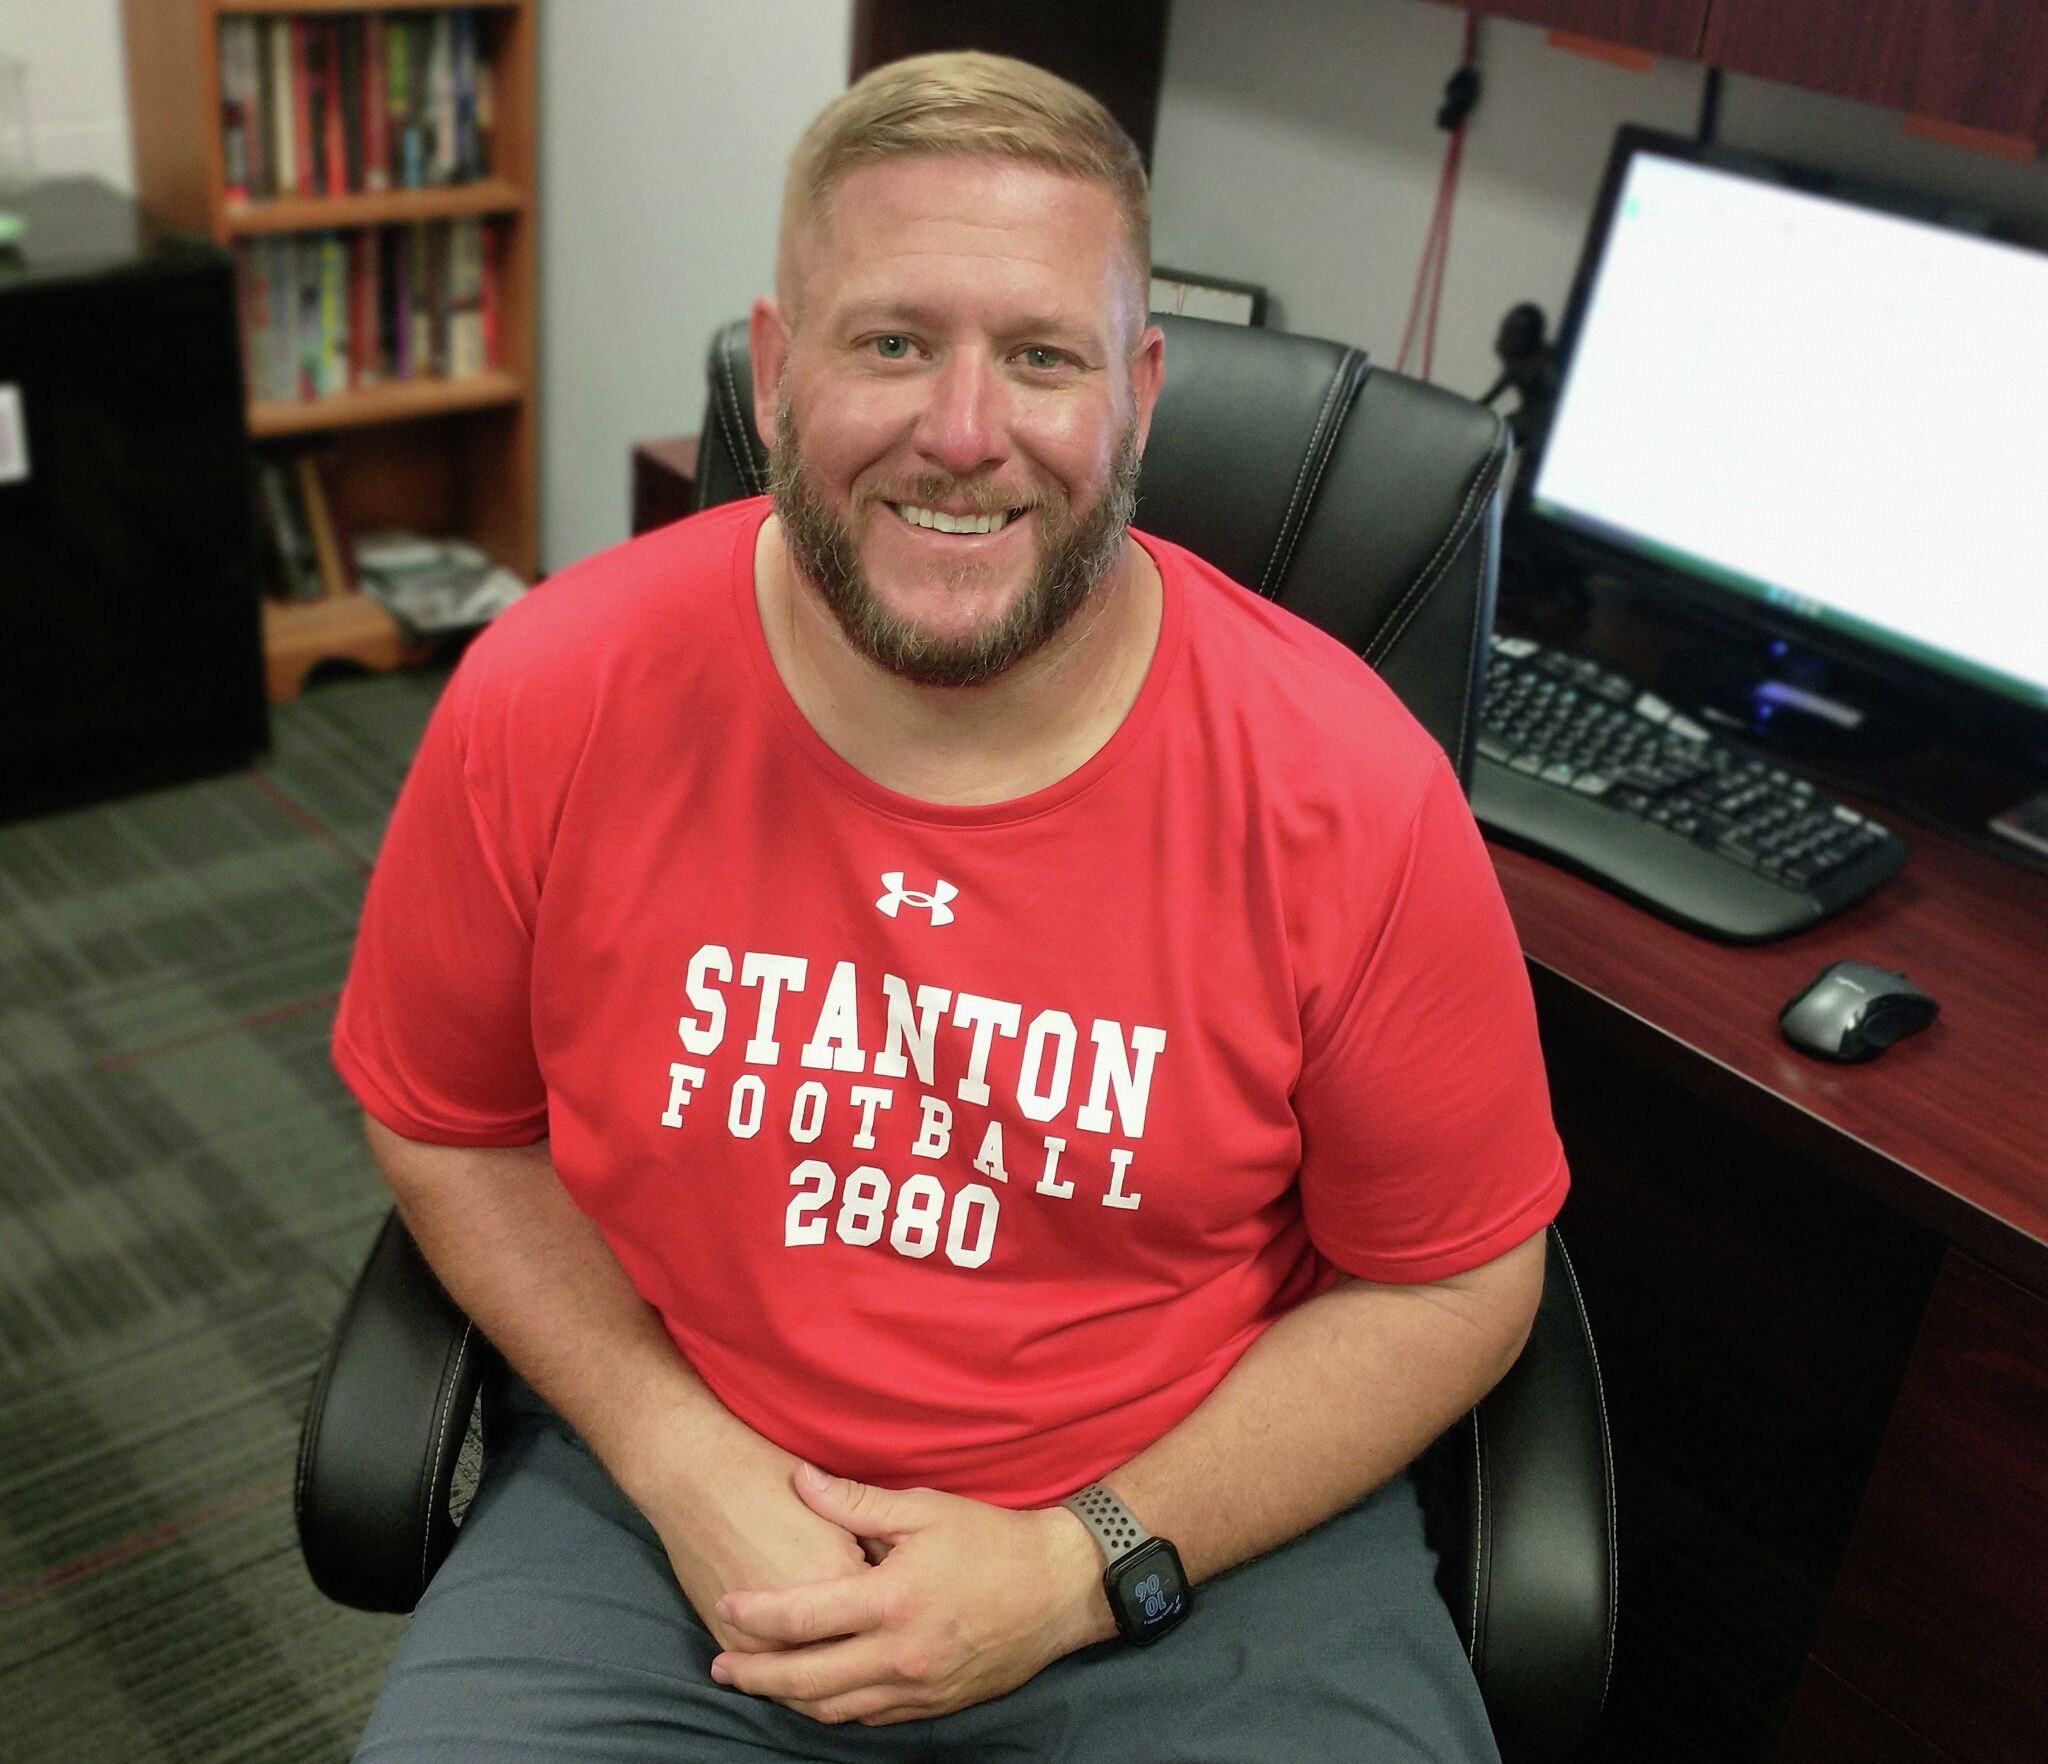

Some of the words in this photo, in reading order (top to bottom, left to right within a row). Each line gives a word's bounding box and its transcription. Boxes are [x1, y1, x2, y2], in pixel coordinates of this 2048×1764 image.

[678, 943, 1167, 1139] STANTON
[661, 1062, 1142, 1211] FOOTBALL
[785, 1159, 1000, 1269] 2880
